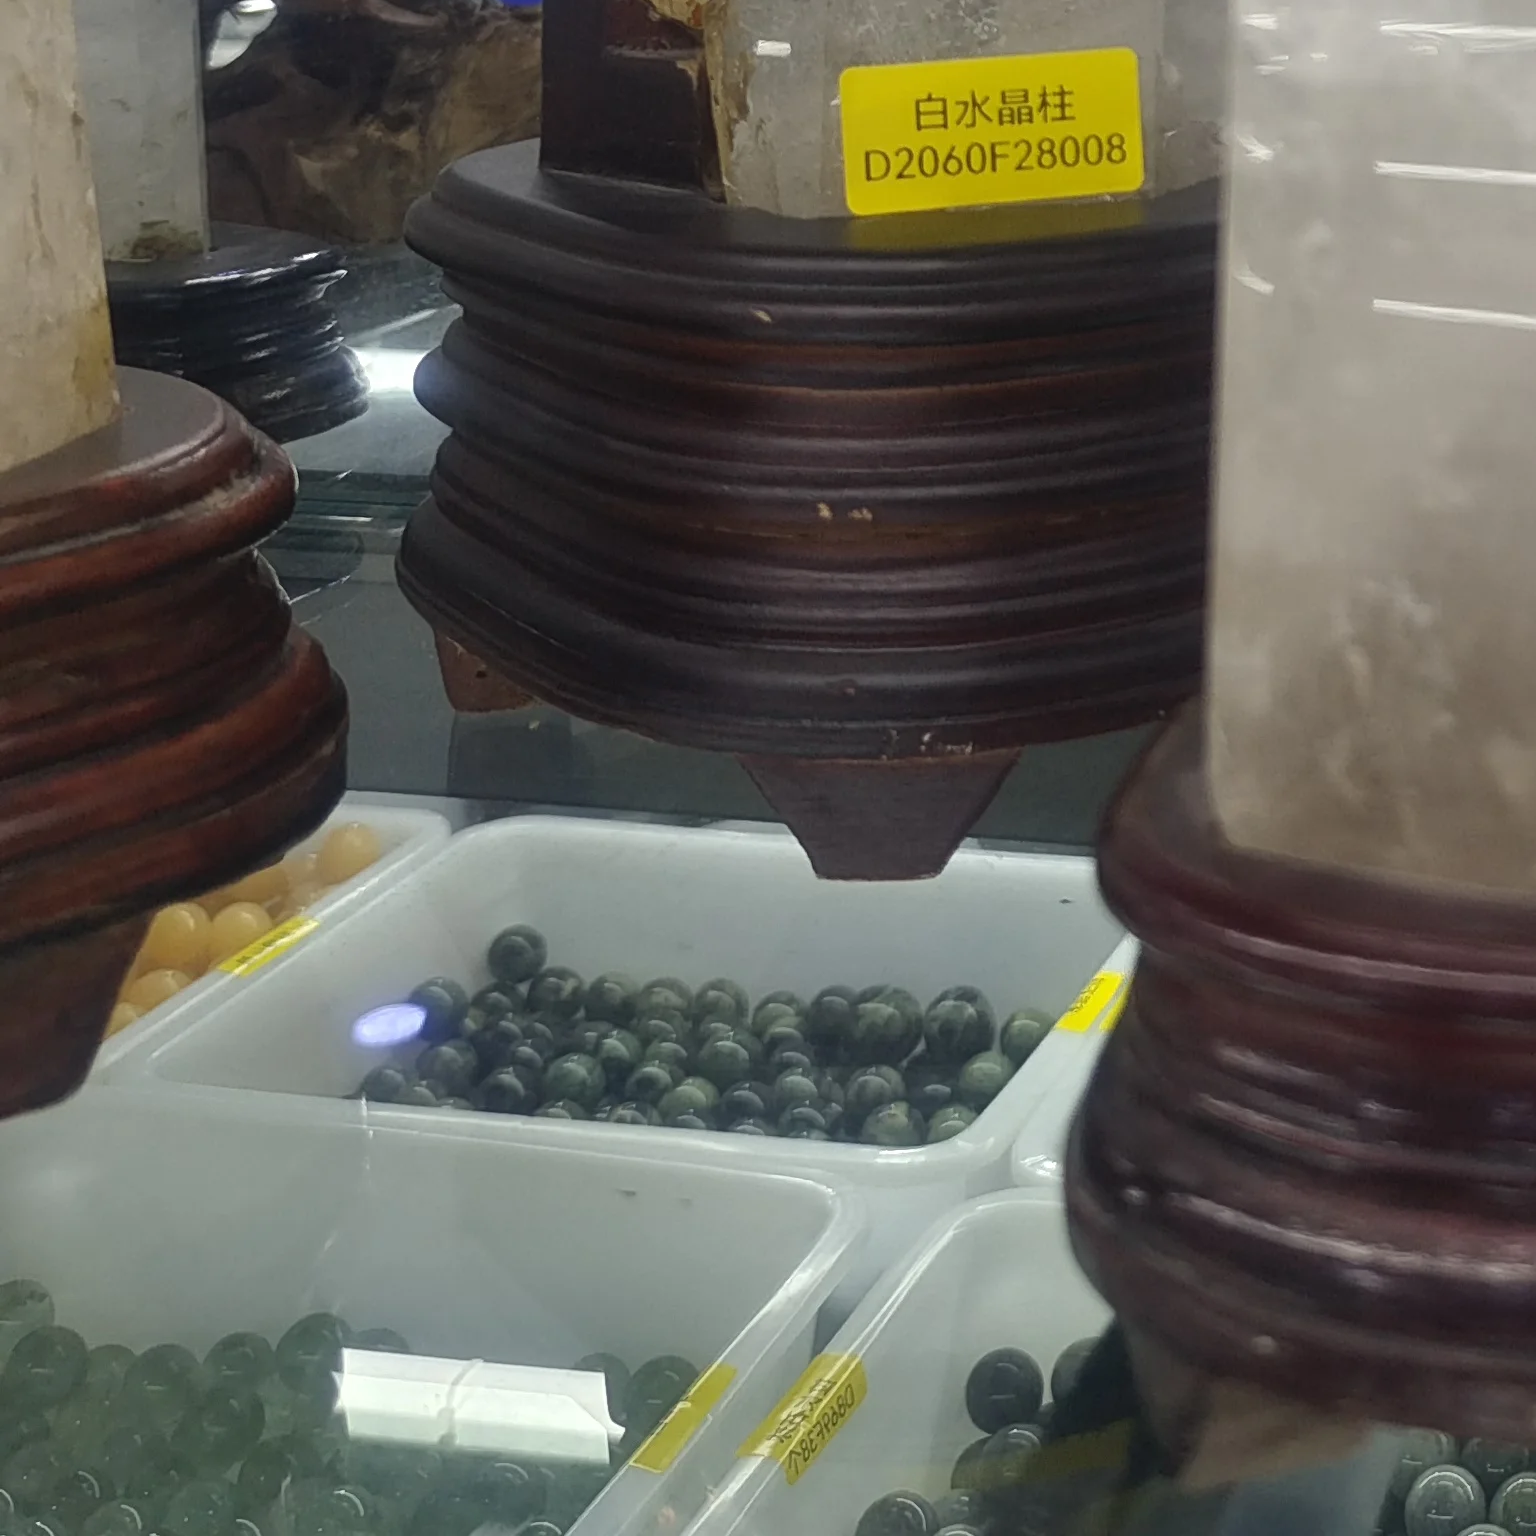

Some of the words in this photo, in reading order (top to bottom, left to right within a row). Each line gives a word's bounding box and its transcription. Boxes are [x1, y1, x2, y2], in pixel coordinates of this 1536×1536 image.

[914, 84, 1077, 132] 白水晶柱
[864, 131, 1128, 183] D2060F28008
